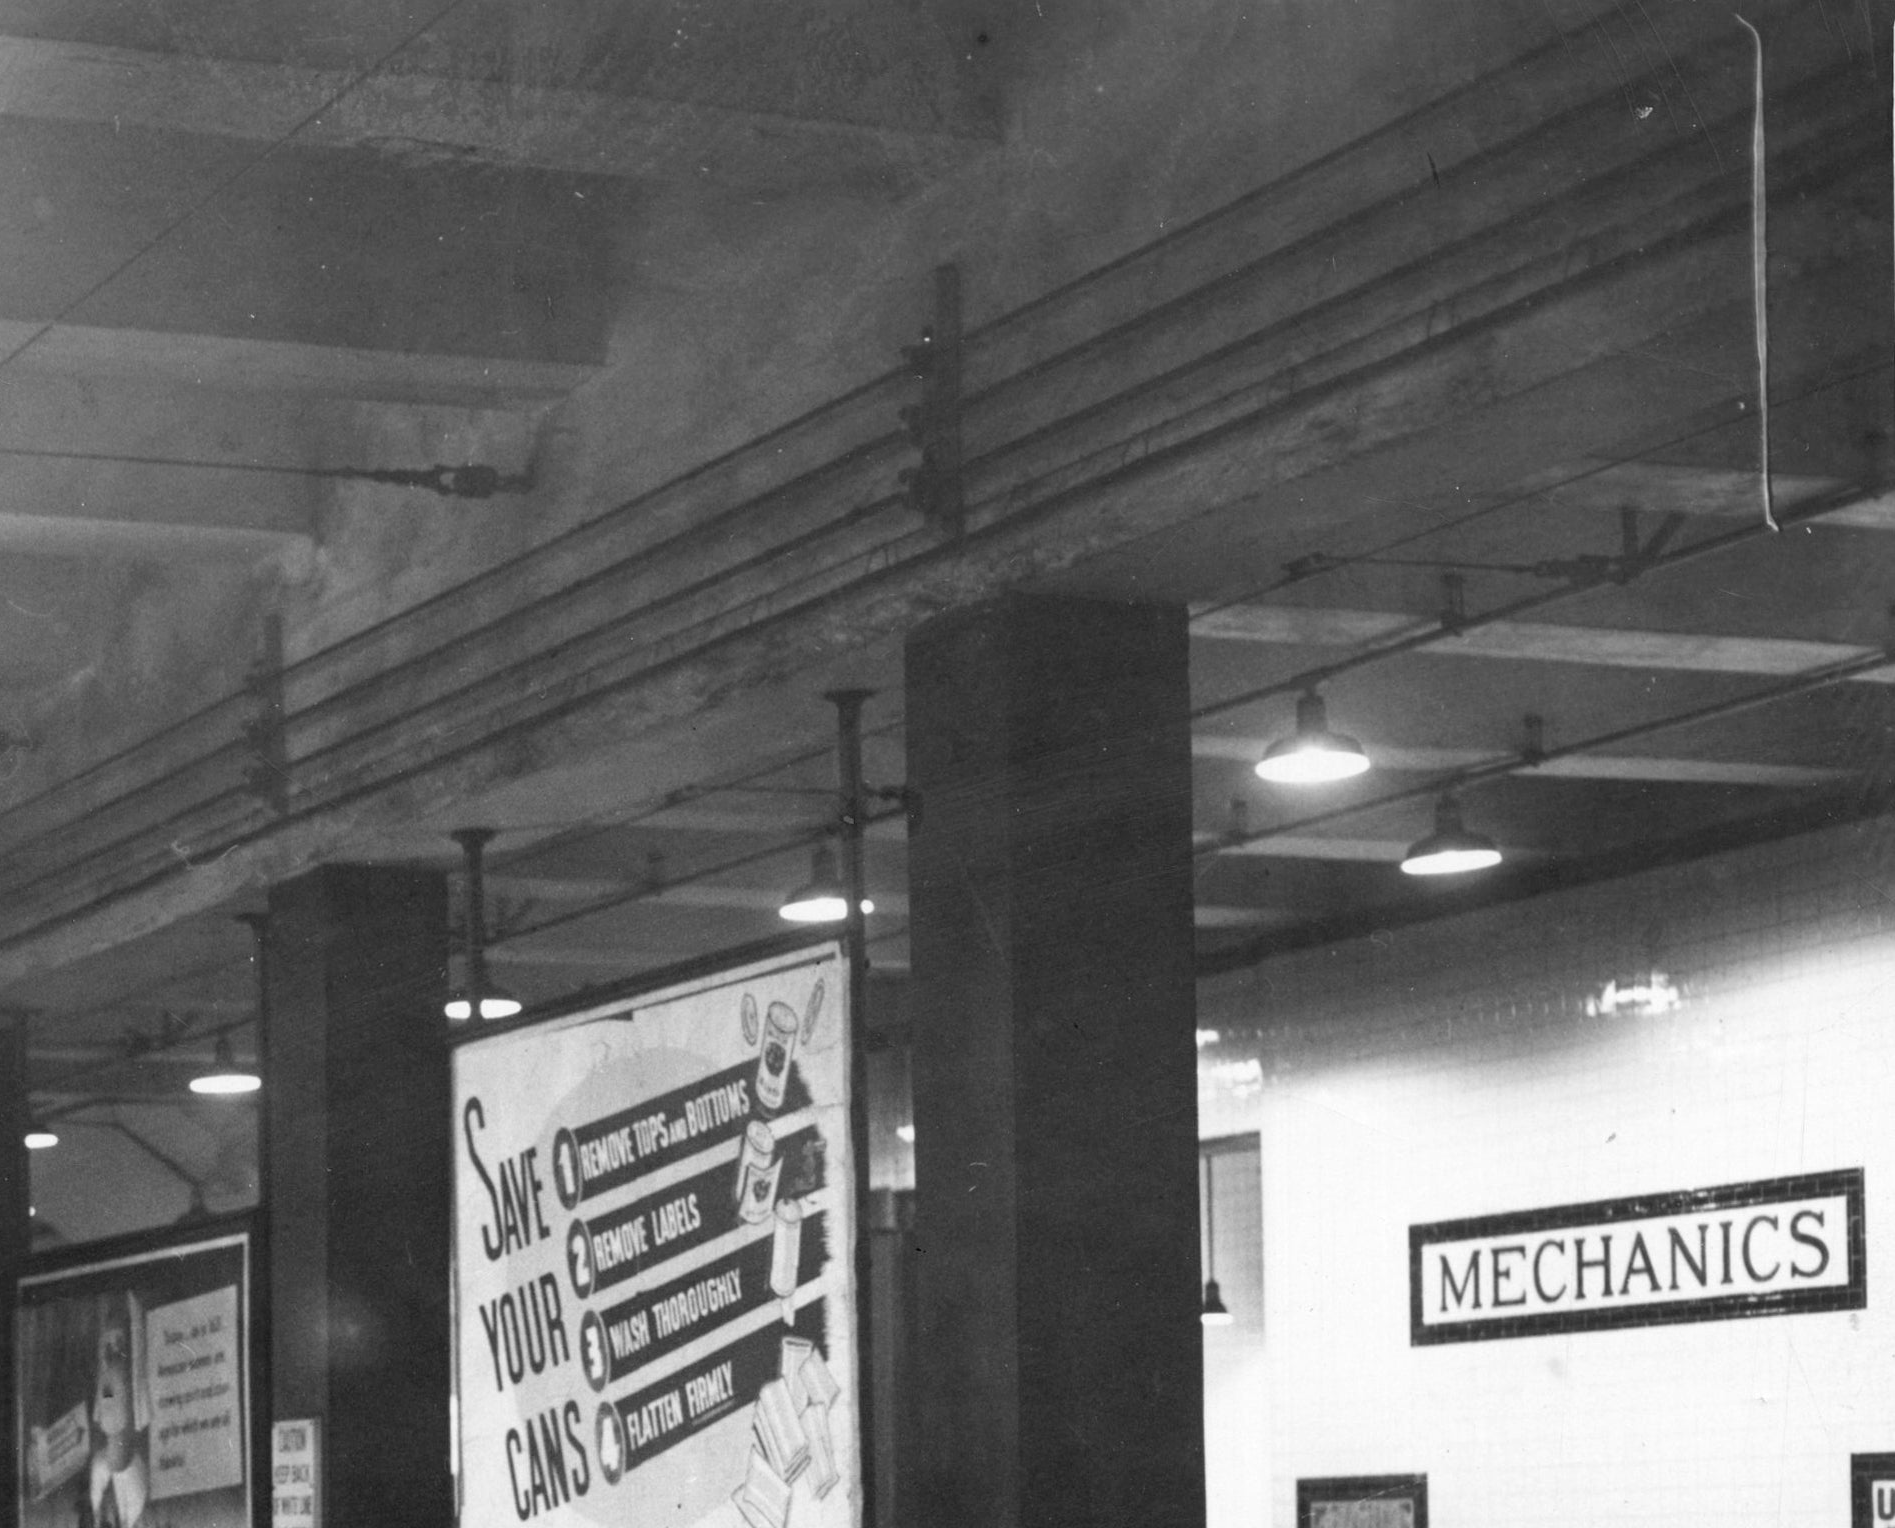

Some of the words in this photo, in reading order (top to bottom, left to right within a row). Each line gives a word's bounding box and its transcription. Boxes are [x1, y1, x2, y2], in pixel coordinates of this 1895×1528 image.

[464, 1096, 551, 1262] SAVE
[555, 1136, 577, 1196] 1
[580, 1127, 635, 1181] REMOVE
[633, 1112, 671, 1159] TOPS
[684, 1079, 750, 1138] BOTTOMS
[571, 1230, 591, 1288] 2
[592, 1218, 647, 1273] REMOVE
[652, 1193, 701, 1246] LABELS
[1438, 1210, 1831, 1314] MECHANICS
[479, 1271, 571, 1392] YOUR
[584, 1320, 605, 1377] 3
[610, 1311, 650, 1358] WASH
[655, 1267, 743, 1341] THOROUGHLY
[505, 1399, 591, 1521] CANS
[597, 1409, 622, 1478] 4
[626, 1392, 684, 1451] FLATTEN
[687, 1360, 735, 1419] FIRMLY
